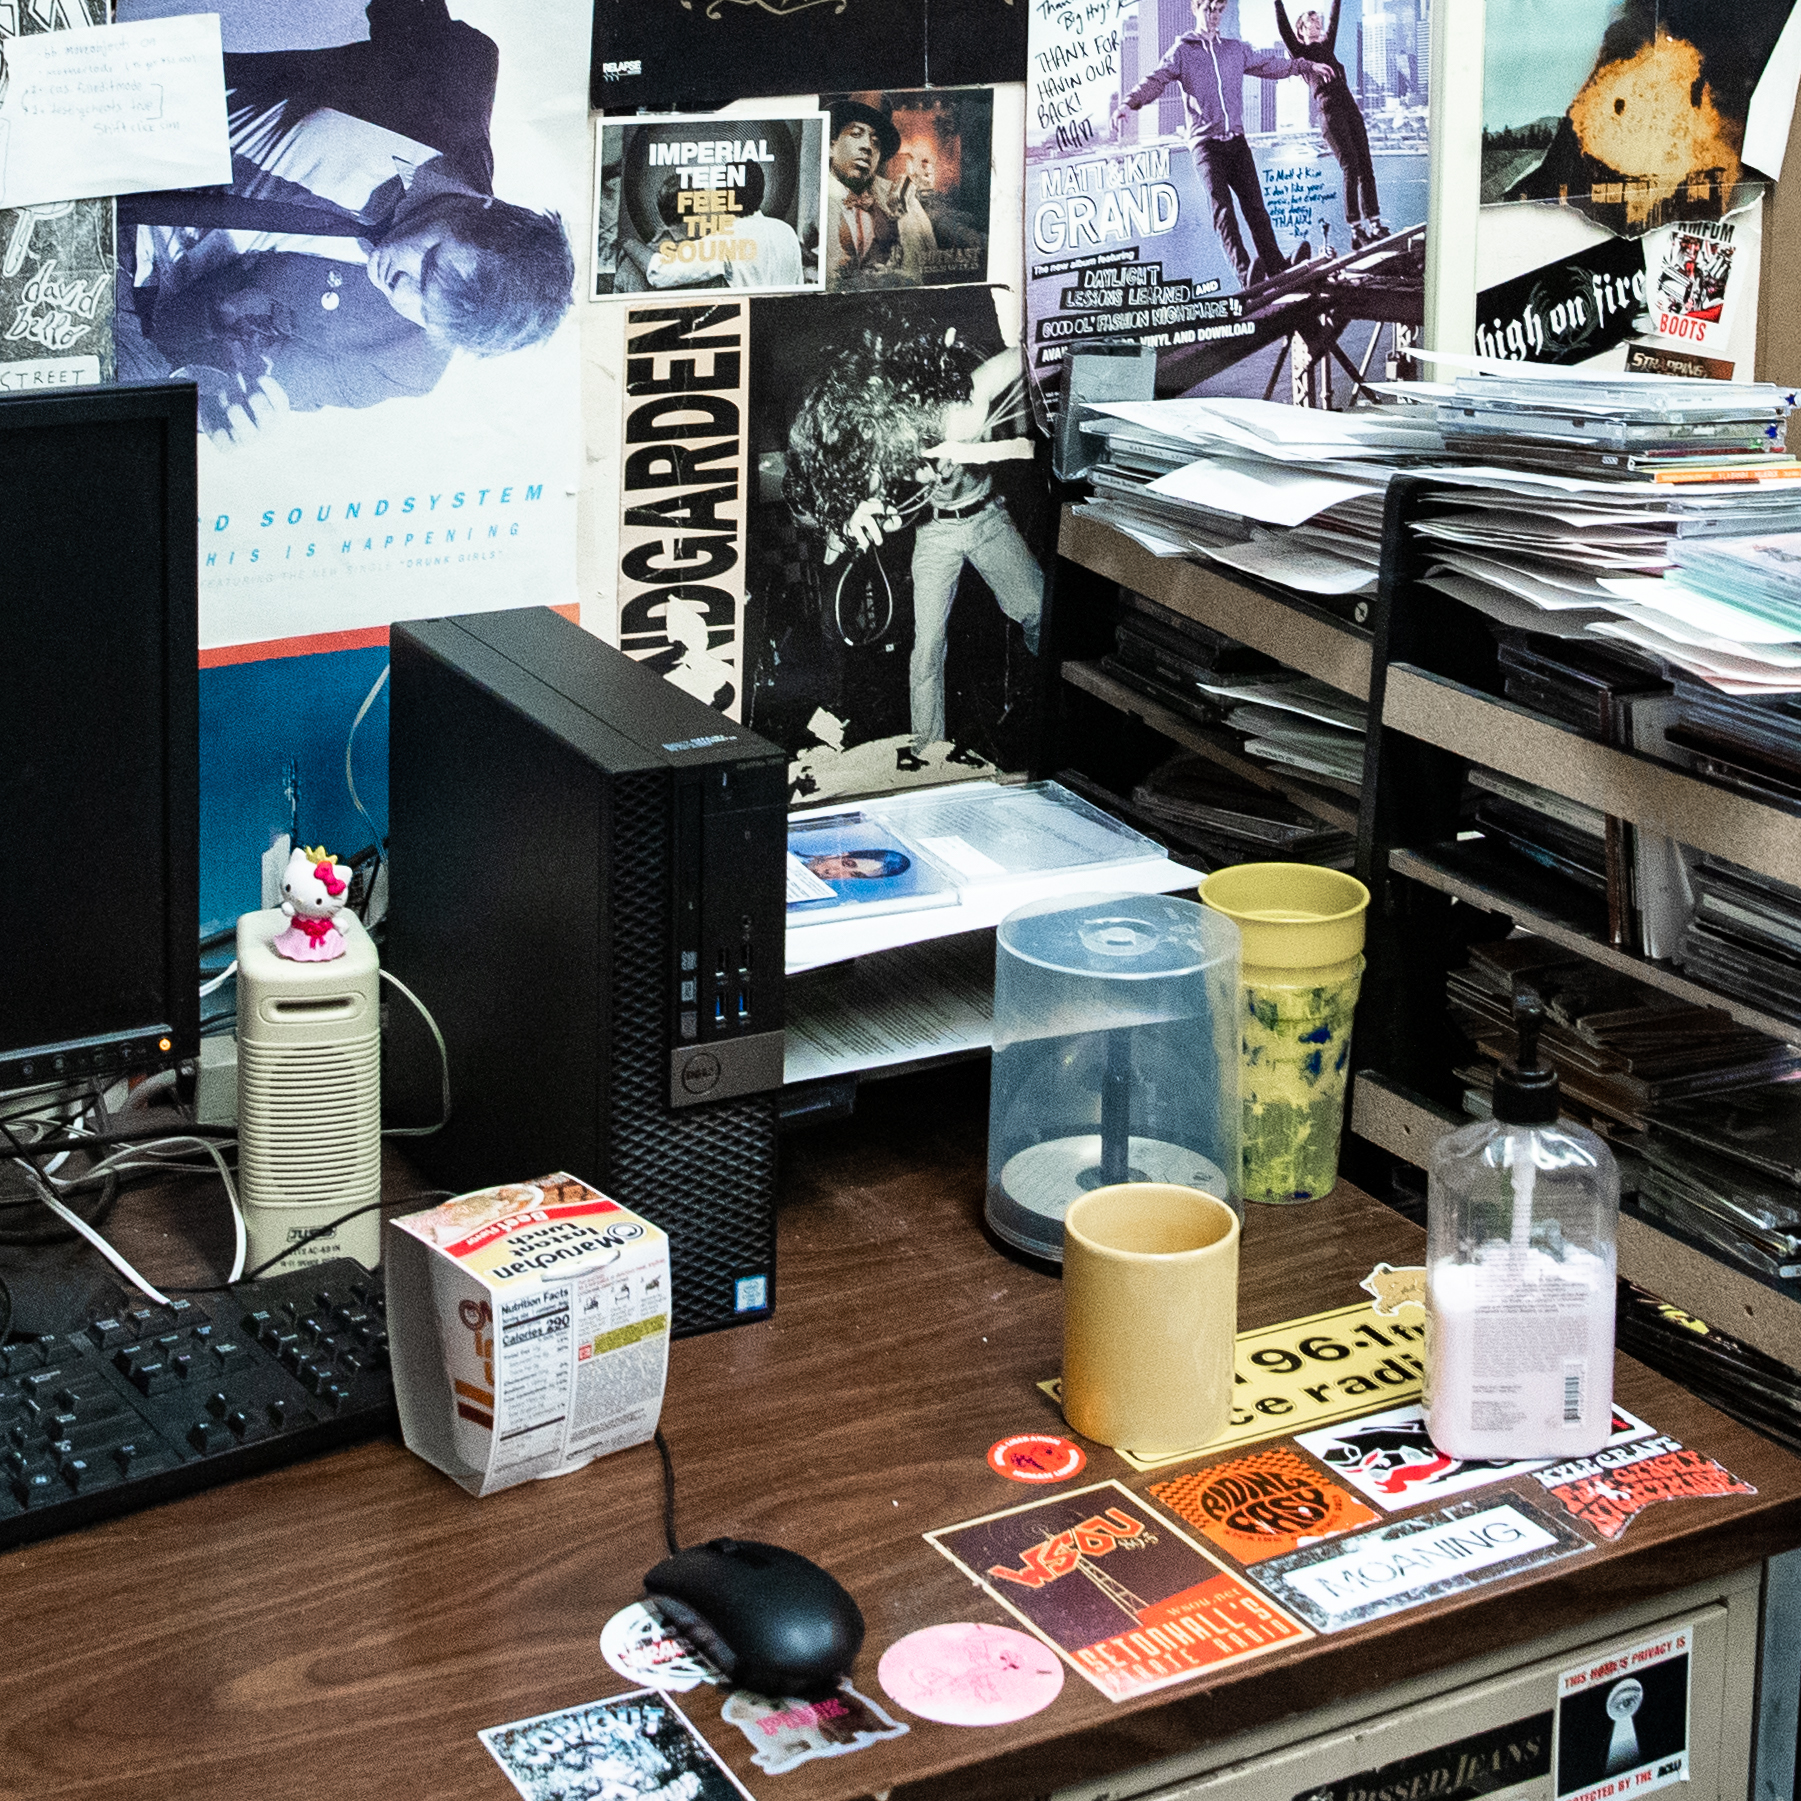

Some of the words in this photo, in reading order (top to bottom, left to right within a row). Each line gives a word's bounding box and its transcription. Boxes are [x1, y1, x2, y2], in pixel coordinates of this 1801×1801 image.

[603, 60, 641, 74] RELAPSE
[1035, 41, 1087, 74] THANX
[1094, 30, 1120, 55] FOR
[1037, 73, 1082, 102] HAVIN
[1086, 54, 1117, 82] OUR
[1037, 92, 1082, 129] BACK!
[649, 139, 774, 167] IMPERIAL
[675, 164, 746, 190] TEEN
[677, 188, 743, 215] FEEL
[683, 215, 735, 237] THE
[1032, 182, 1180, 255] GRAND
[658, 238, 758, 265] SOUND
[1034, 265, 1049, 275] The
[1050, 262, 1069, 272] new
[1070, 256, 1096, 269] album
[1097, 251, 1135, 266] featuring
[23, 259, 108, 319] david
[1084, 266, 1160, 288] DAYLIGHT
[1066, 290, 1123, 308] LESSONS
[1128, 285, 1191, 305] LEARNED
[1195, 281, 1219, 296] AND
[6, 307, 92, 350] bello
[1042, 322, 1073, 338] GOOD
[1097, 310, 1149, 333] FASHION
[1152, 302, 1229, 327] NIGHTMARE
[1140, 334, 1171, 347] VINYL
[1173, 329, 1196, 344] AND
[1197, 322, 1255, 341] DOWNLOAD
[1476, 304, 1544, 363] high
[1549, 289, 1586, 334] on
[1660, 313, 1707, 342] BOOTS
[0, 368, 86, 391] STREET
[259, 483, 545, 528] SOUNDSYSTEM
[285, 541, 317, 560] IS
[341, 522, 521, 554] HAPPENING
[500, 1211, 549, 1233] Beef
[507, 1222, 579, 1245] Lunch
[493, 1234, 625, 1279] Maruchan
[509, 1226, 600, 1258] Instant
[501, 1297, 541, 1314] Nutrition
[543, 1288, 569, 1302] Facts
[502, 1325, 543, 1347] Calories
[547, 1314, 570, 1334] 290
[1596, 1436, 1682, 1470] CRAFT
[1201, 1470, 1302, 1521] RIDING
[1225, 1486, 1326, 1535] EASY
[988, 1507, 1146, 1589] WSOU
[1316, 1520, 1527, 1600] MOANING
[1564, 1670, 1587, 1690] THIS
[1631, 1640, 1674, 1665] PRIVACY
[1676, 1635, 1686, 1648] IS
[1618, 1777, 1631, 1791] BY
[1635, 1770, 1653, 1784] THE
